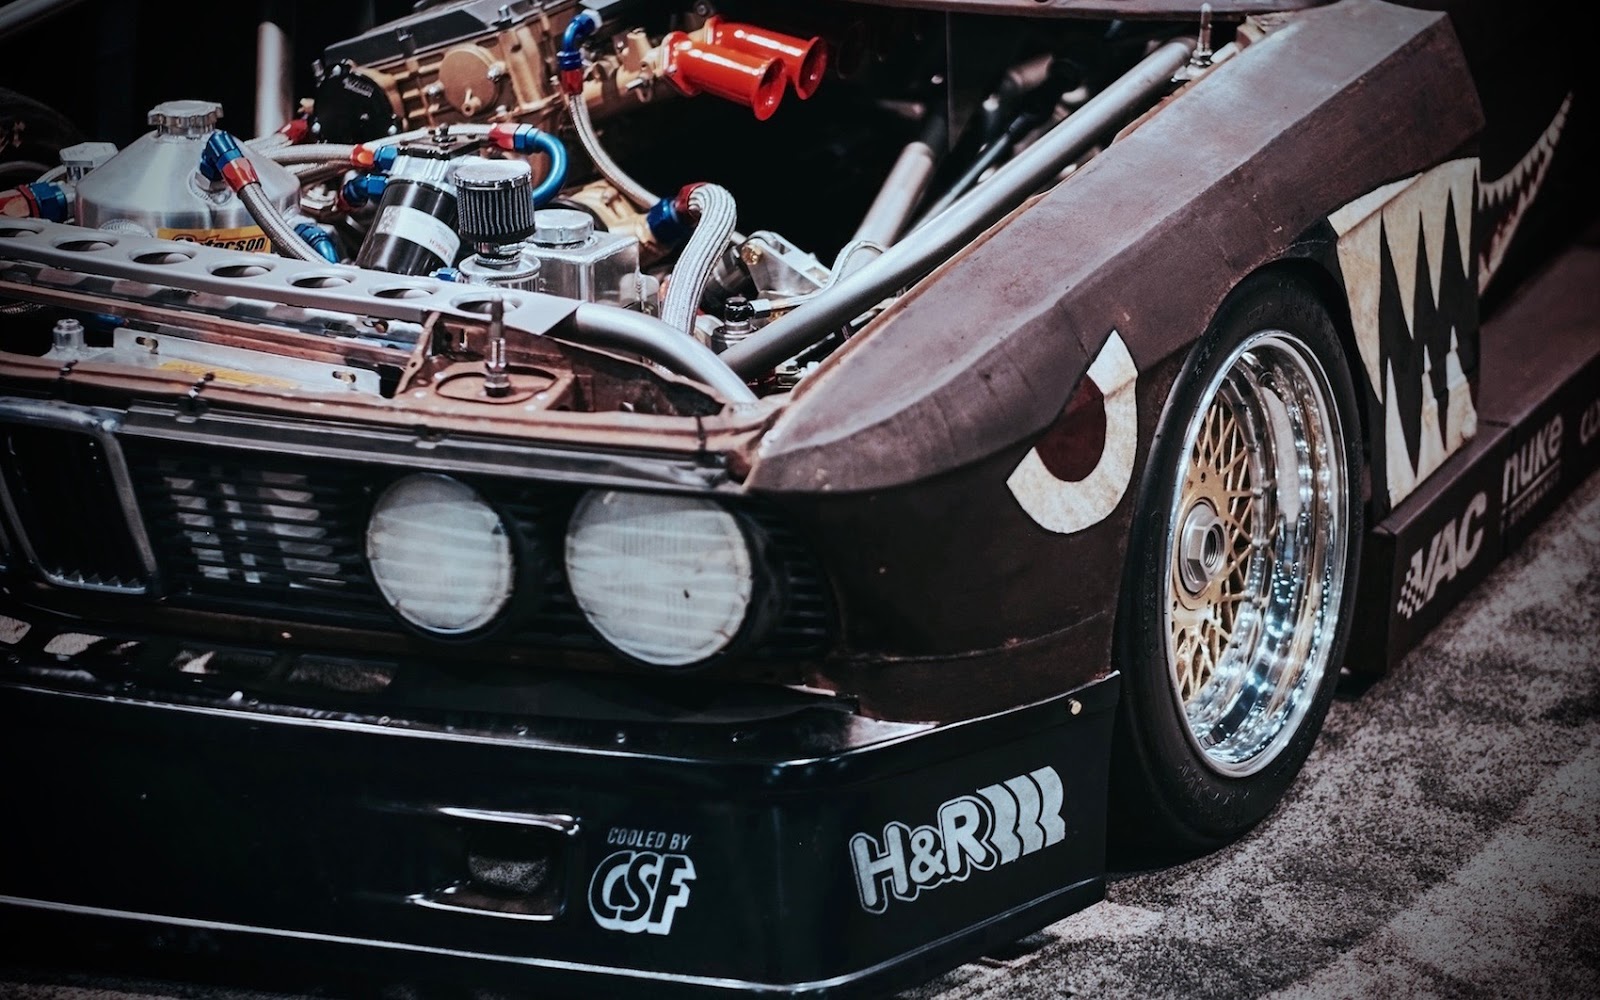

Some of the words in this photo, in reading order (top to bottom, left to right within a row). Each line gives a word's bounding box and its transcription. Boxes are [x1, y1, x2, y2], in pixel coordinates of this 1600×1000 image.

[1397, 491, 1487, 619] VAC
[607, 827, 666, 849] COOLED
[669, 832, 692, 851] BY
[849, 795, 998, 914] H&R
[588, 850, 697, 936] CSF
